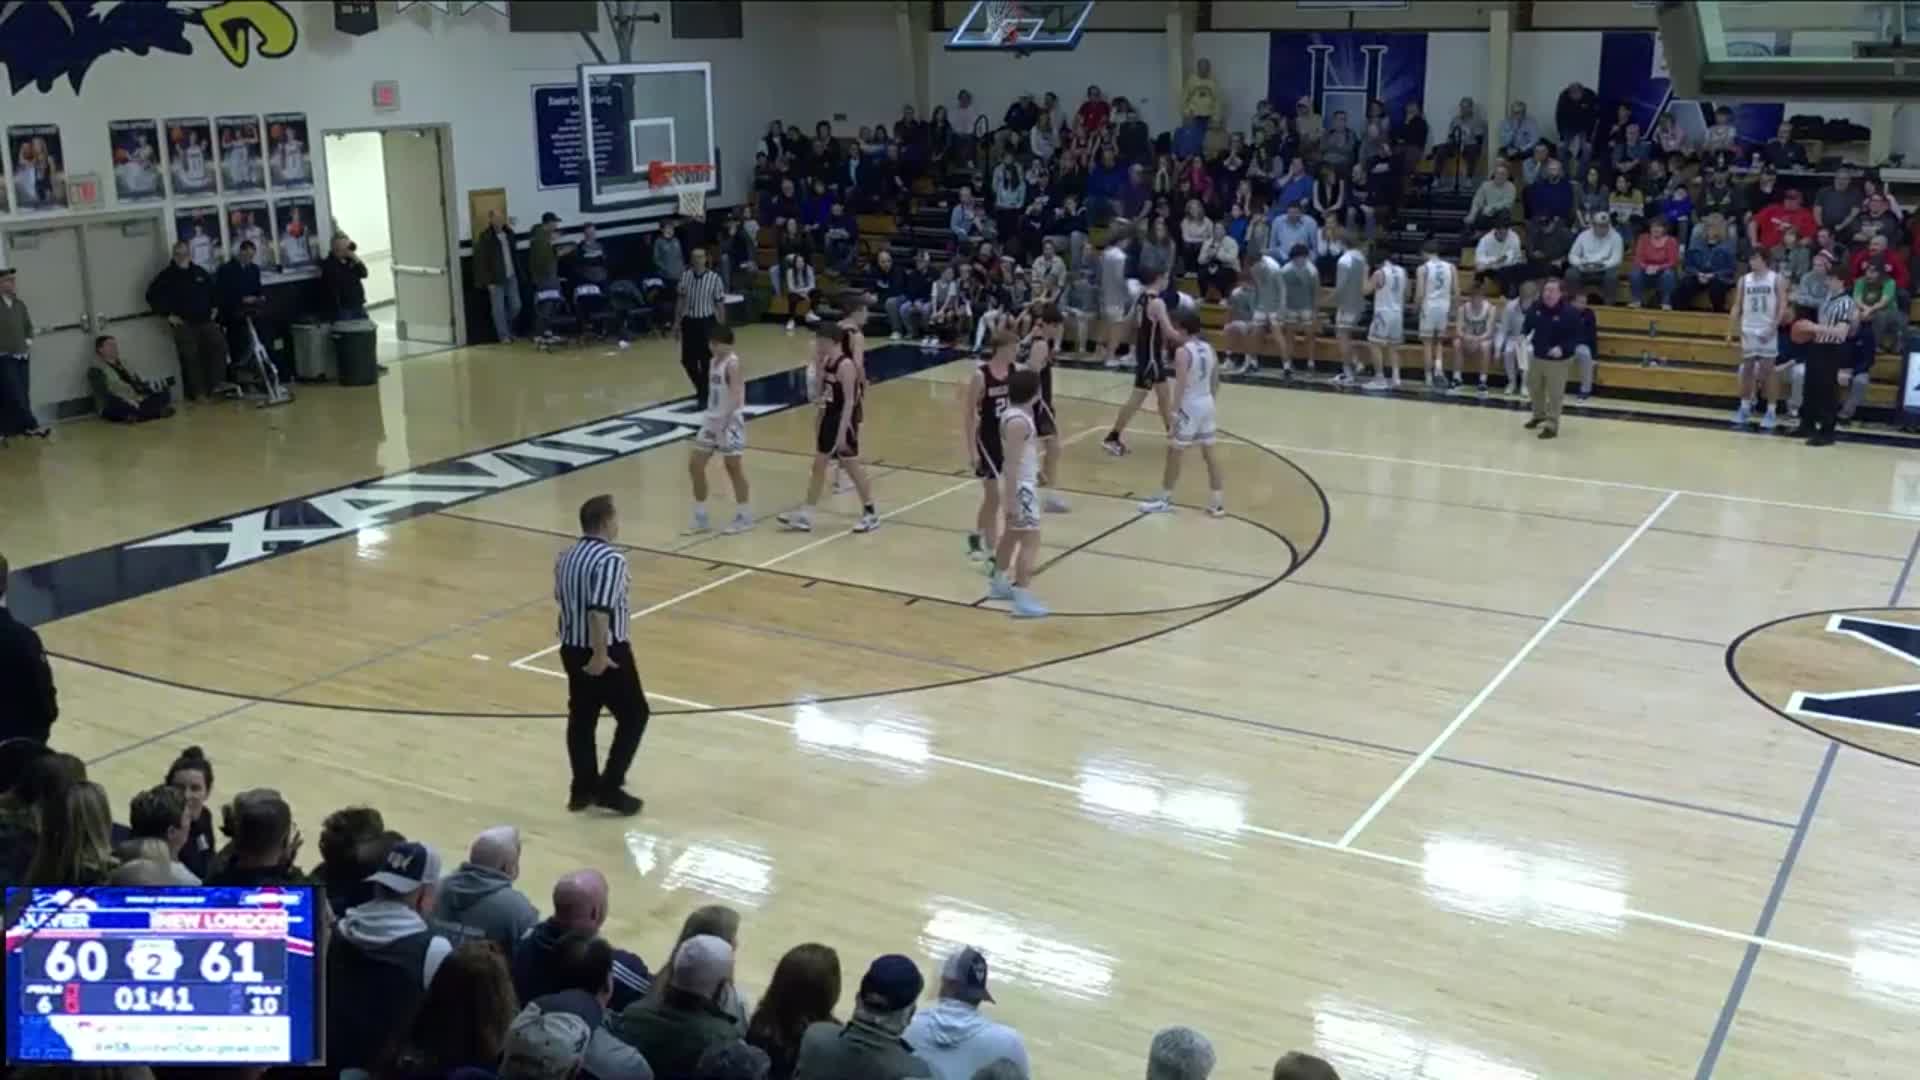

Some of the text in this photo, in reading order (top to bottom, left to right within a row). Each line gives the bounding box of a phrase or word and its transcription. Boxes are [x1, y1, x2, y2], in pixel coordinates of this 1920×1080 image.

[45, 940, 109, 982] 60
[146, 953, 162, 976] 2
[200, 940, 264, 982] 61
[36, 995, 53, 1014] 6
[114, 986, 194, 1012] 01:41
[250, 996, 279, 1014] 10
